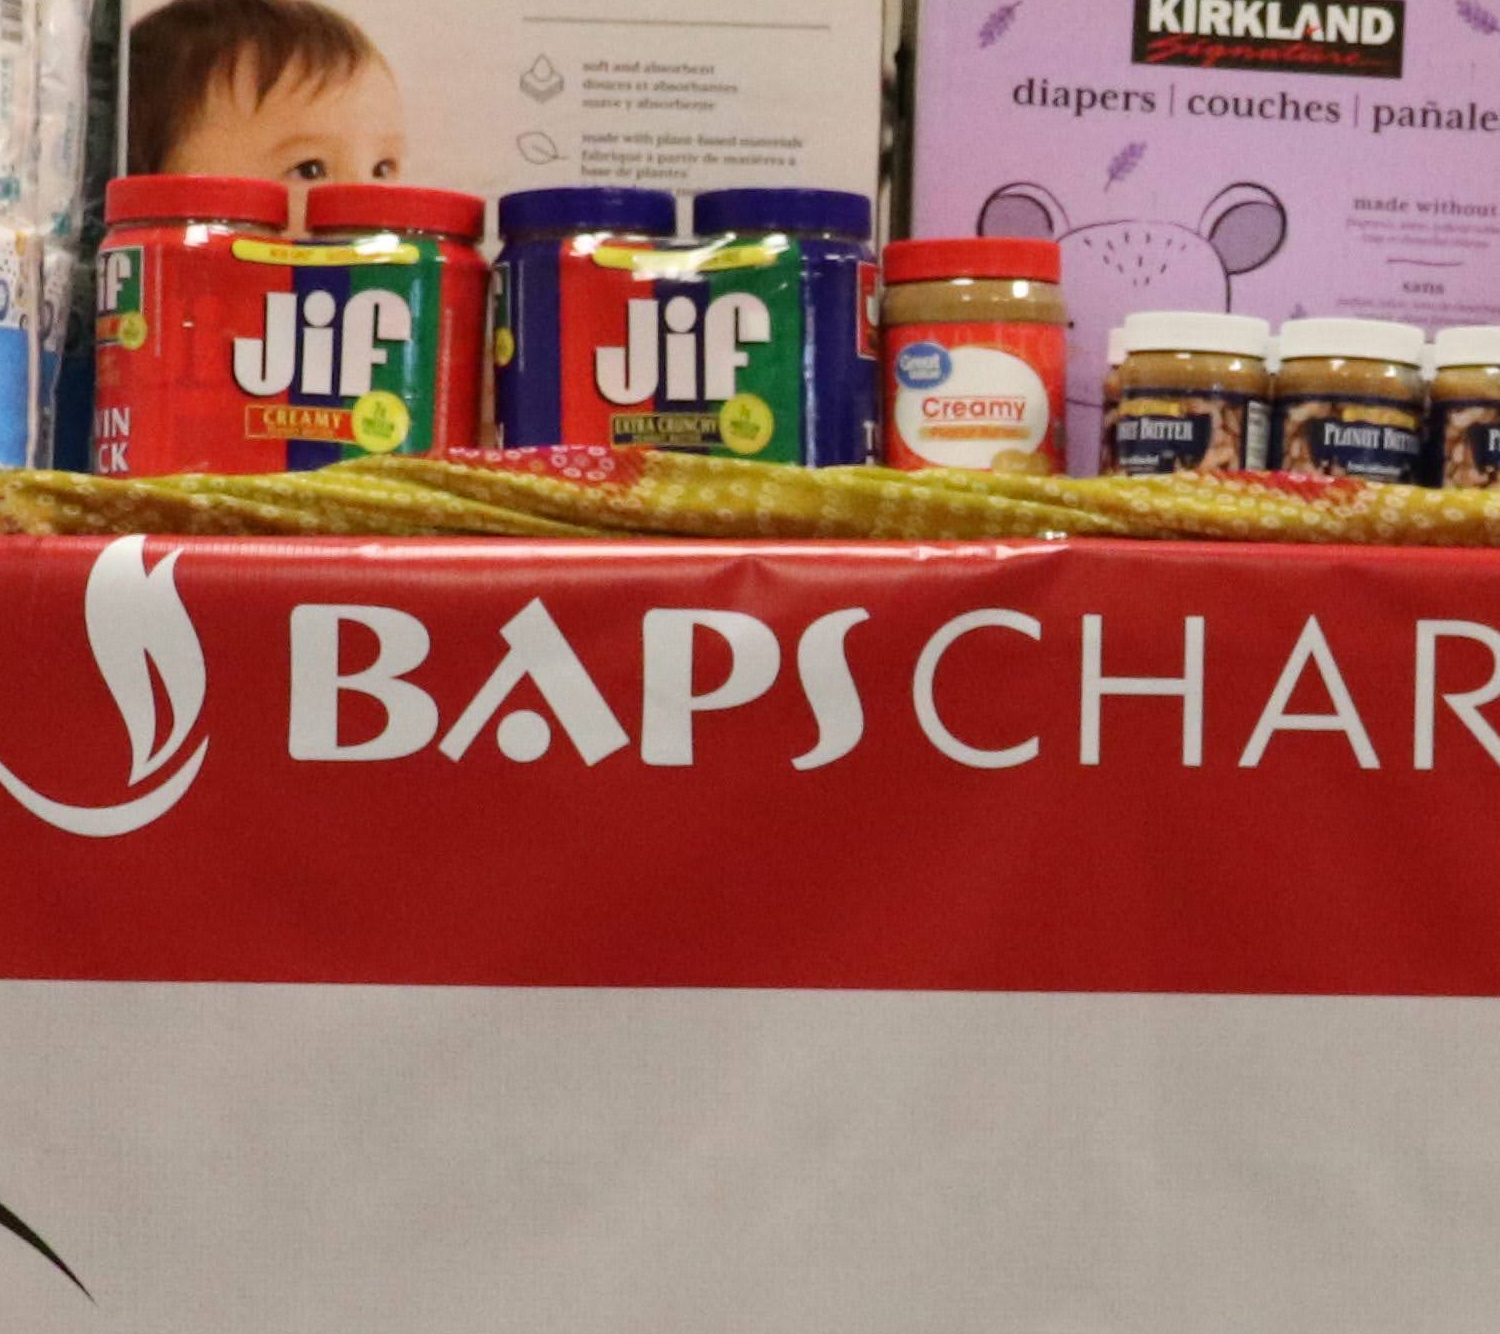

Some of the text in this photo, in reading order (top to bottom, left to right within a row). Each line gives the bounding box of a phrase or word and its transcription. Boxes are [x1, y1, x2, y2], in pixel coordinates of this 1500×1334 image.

[1012, 77, 1156, 117] diapers
[1186, 91, 1341, 126] couches
[1353, 197, 1498, 217] made without
[233, 288, 412, 397] Jif
[595, 292, 772, 405] Jif
[262, 407, 342, 429] CREAMY
[921, 396, 1026, 422] Creamy
[1140, 417, 1194, 441] BUTTER
[1324, 421, 1381, 449] PEANUT
[287, 594, 871, 771] BAPS
